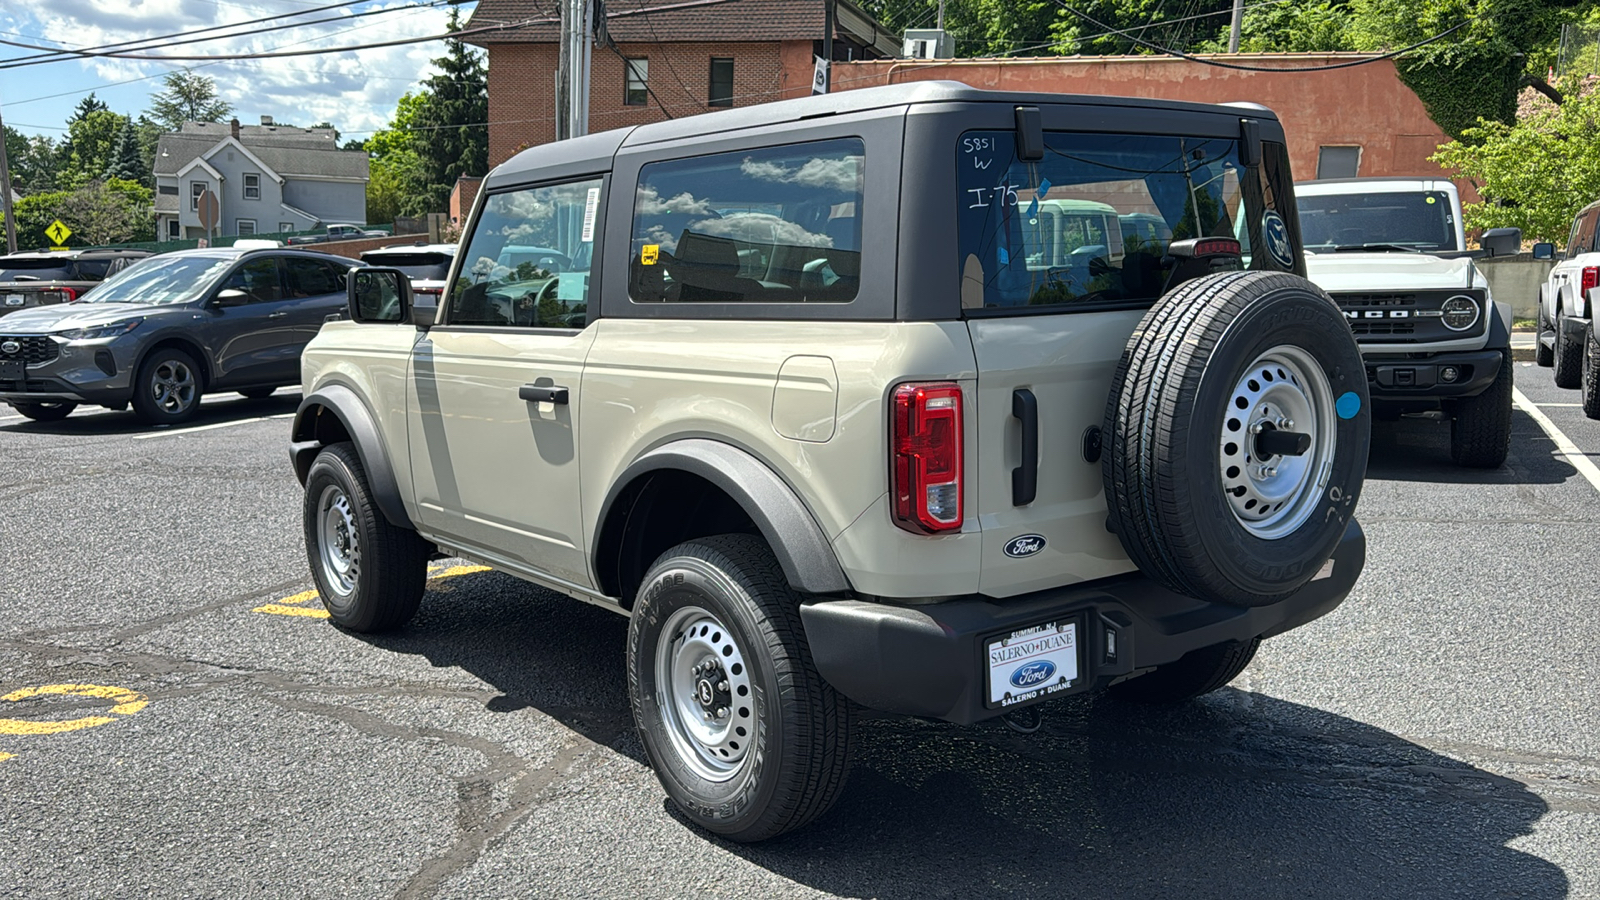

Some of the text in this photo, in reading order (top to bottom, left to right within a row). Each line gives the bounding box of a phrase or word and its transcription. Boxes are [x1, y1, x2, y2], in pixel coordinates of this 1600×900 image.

[974, 156, 993, 170] W
[1012, 538, 1041, 555] Ford
[1046, 621, 1057, 631] NJ
[991, 632, 1073, 664] SALERNO DUANE
[1018, 664, 1047, 685] Ford
[1001, 681, 1072, 707] SALERNO DUANE
